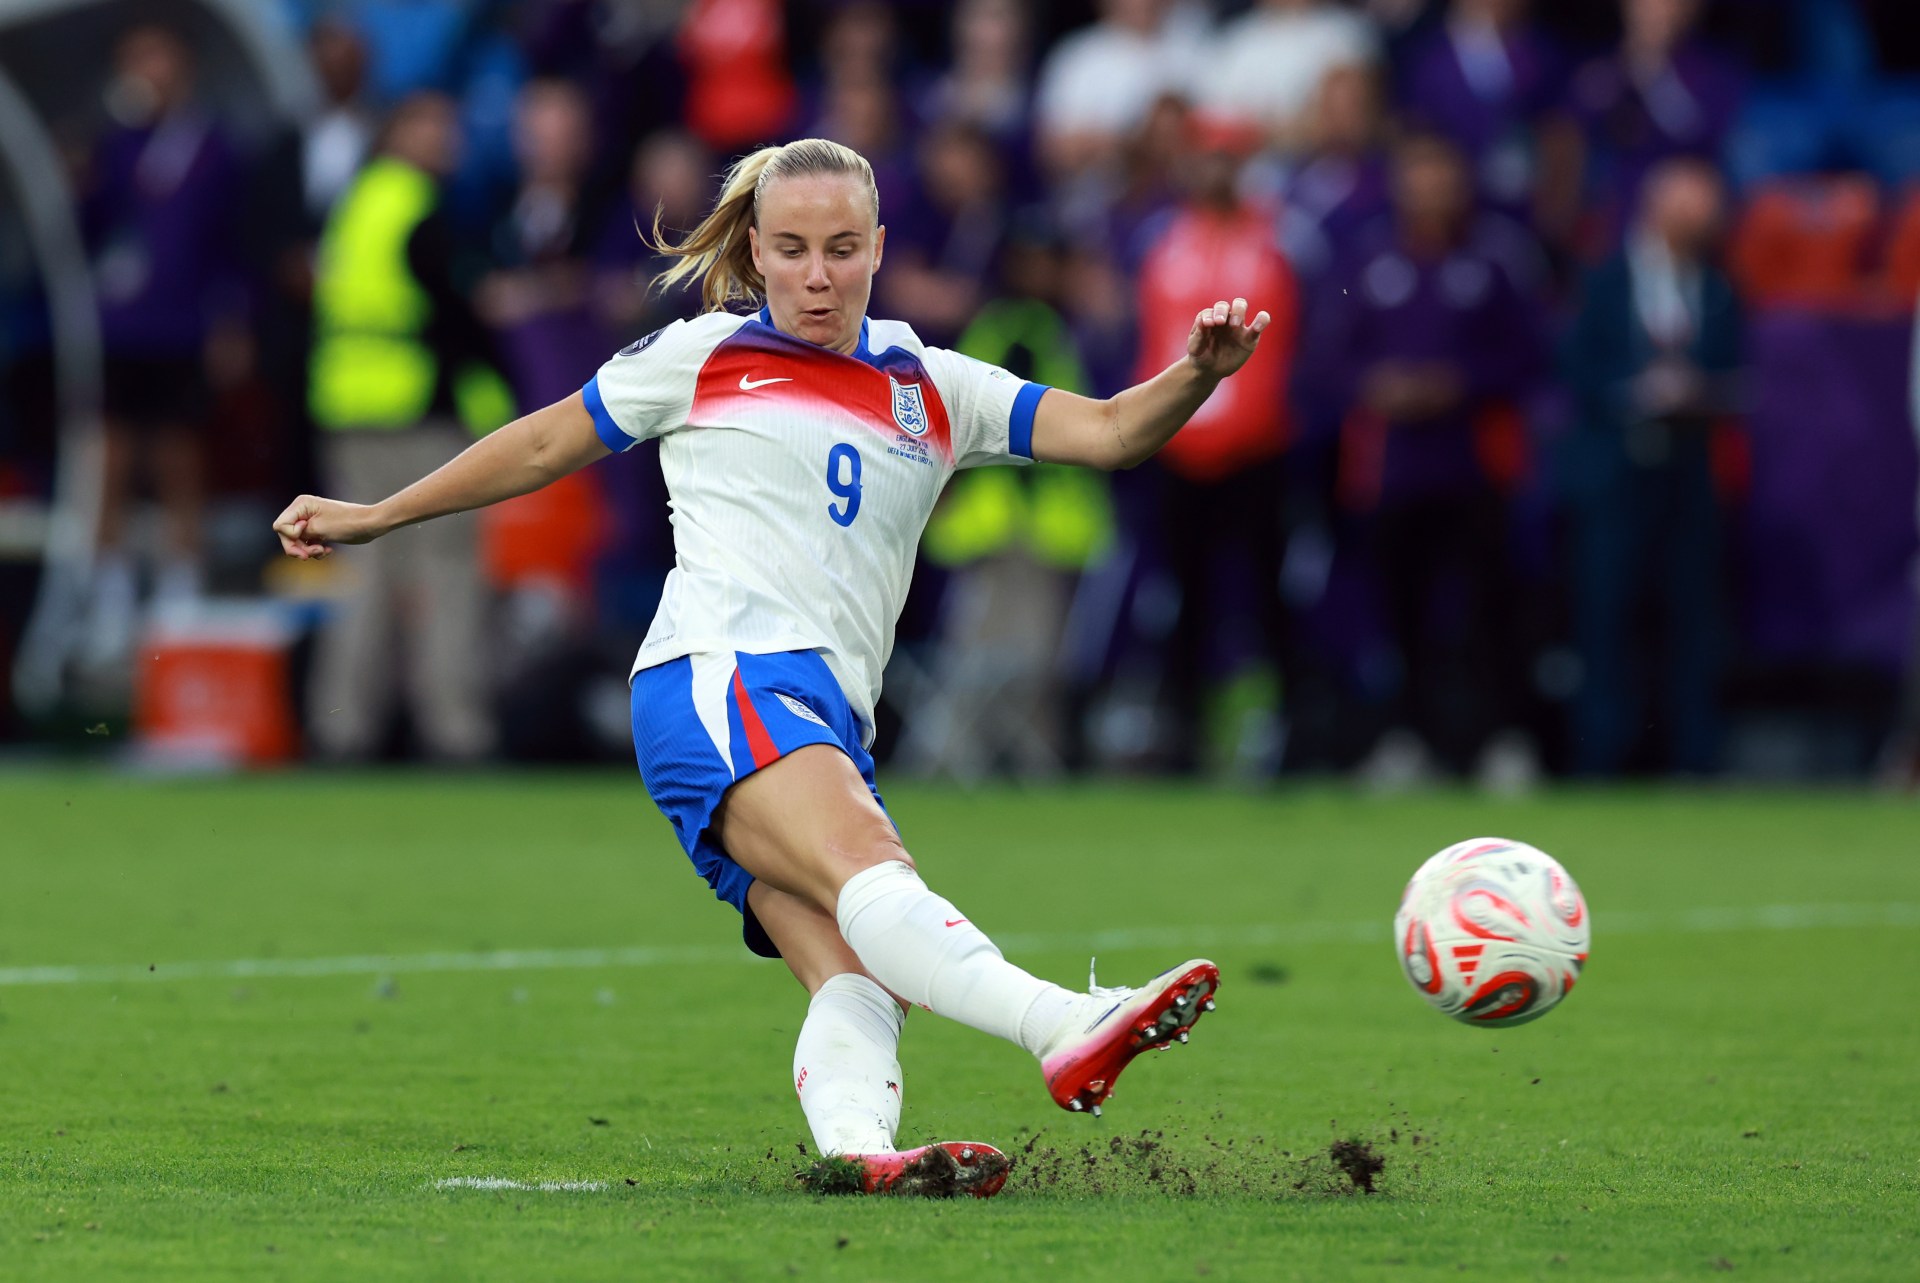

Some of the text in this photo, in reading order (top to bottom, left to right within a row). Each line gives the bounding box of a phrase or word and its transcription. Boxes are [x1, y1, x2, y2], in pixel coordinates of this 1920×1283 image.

[887, 446, 899, 456] UEFA
[918, 454, 928, 464] EURO
[900, 443, 906, 451] 27
[907, 444, 918, 452] JULY
[826, 442, 863, 528] 9
